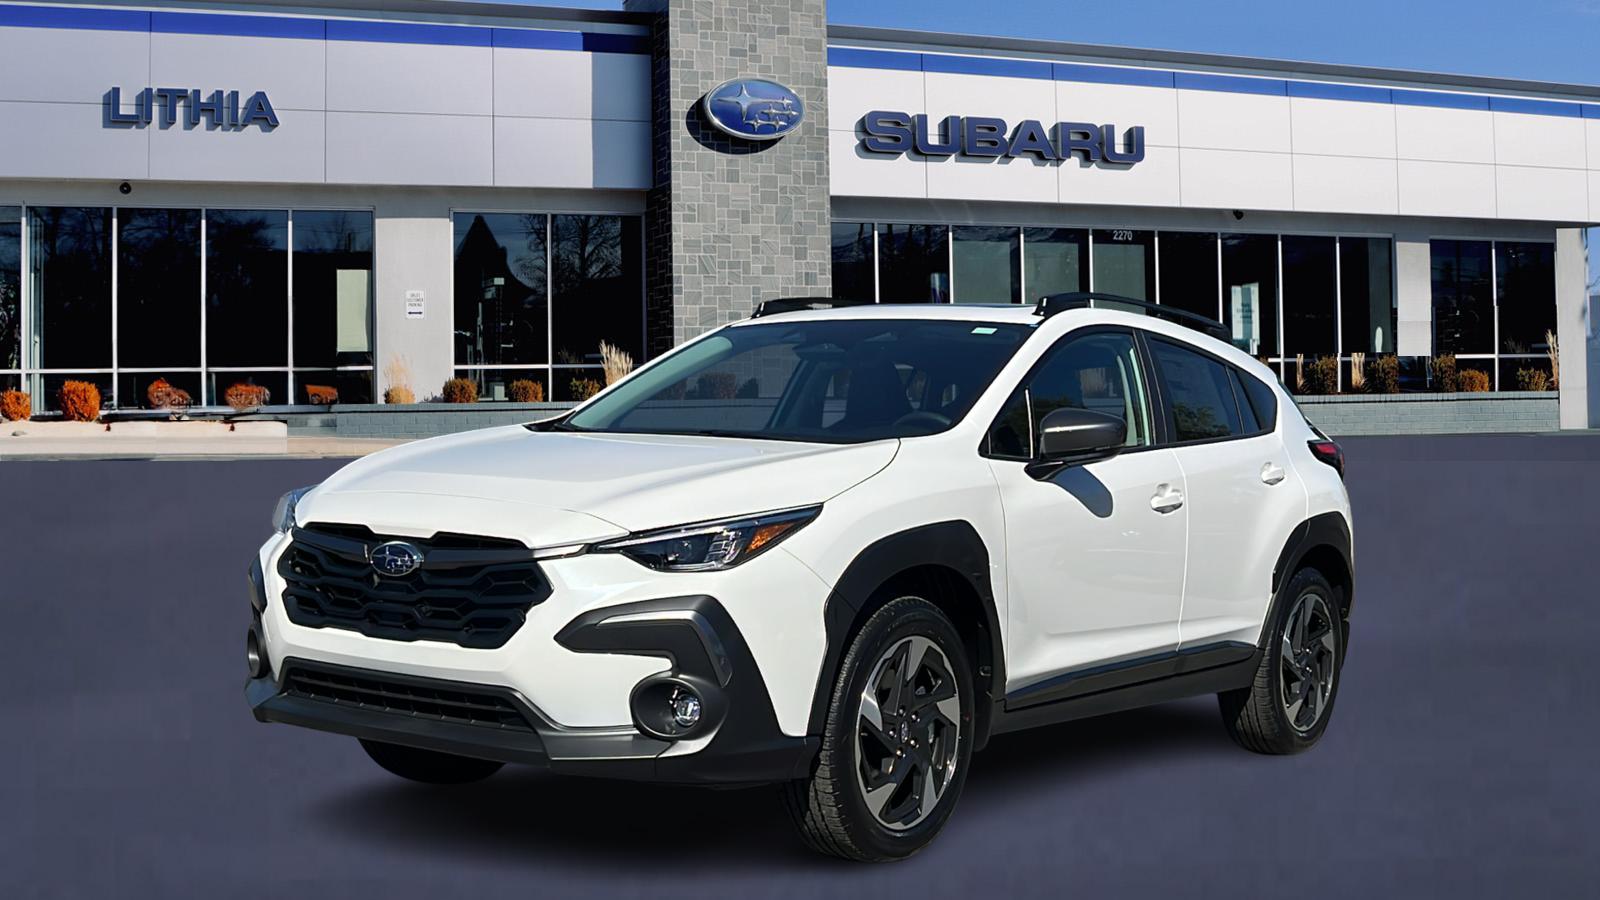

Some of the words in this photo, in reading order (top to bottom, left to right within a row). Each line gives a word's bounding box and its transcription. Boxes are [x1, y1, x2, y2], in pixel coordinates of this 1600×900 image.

[107, 86, 280, 128] LITHIA
[857, 110, 1145, 166] SUBARU
[1112, 230, 1133, 241] 2270
